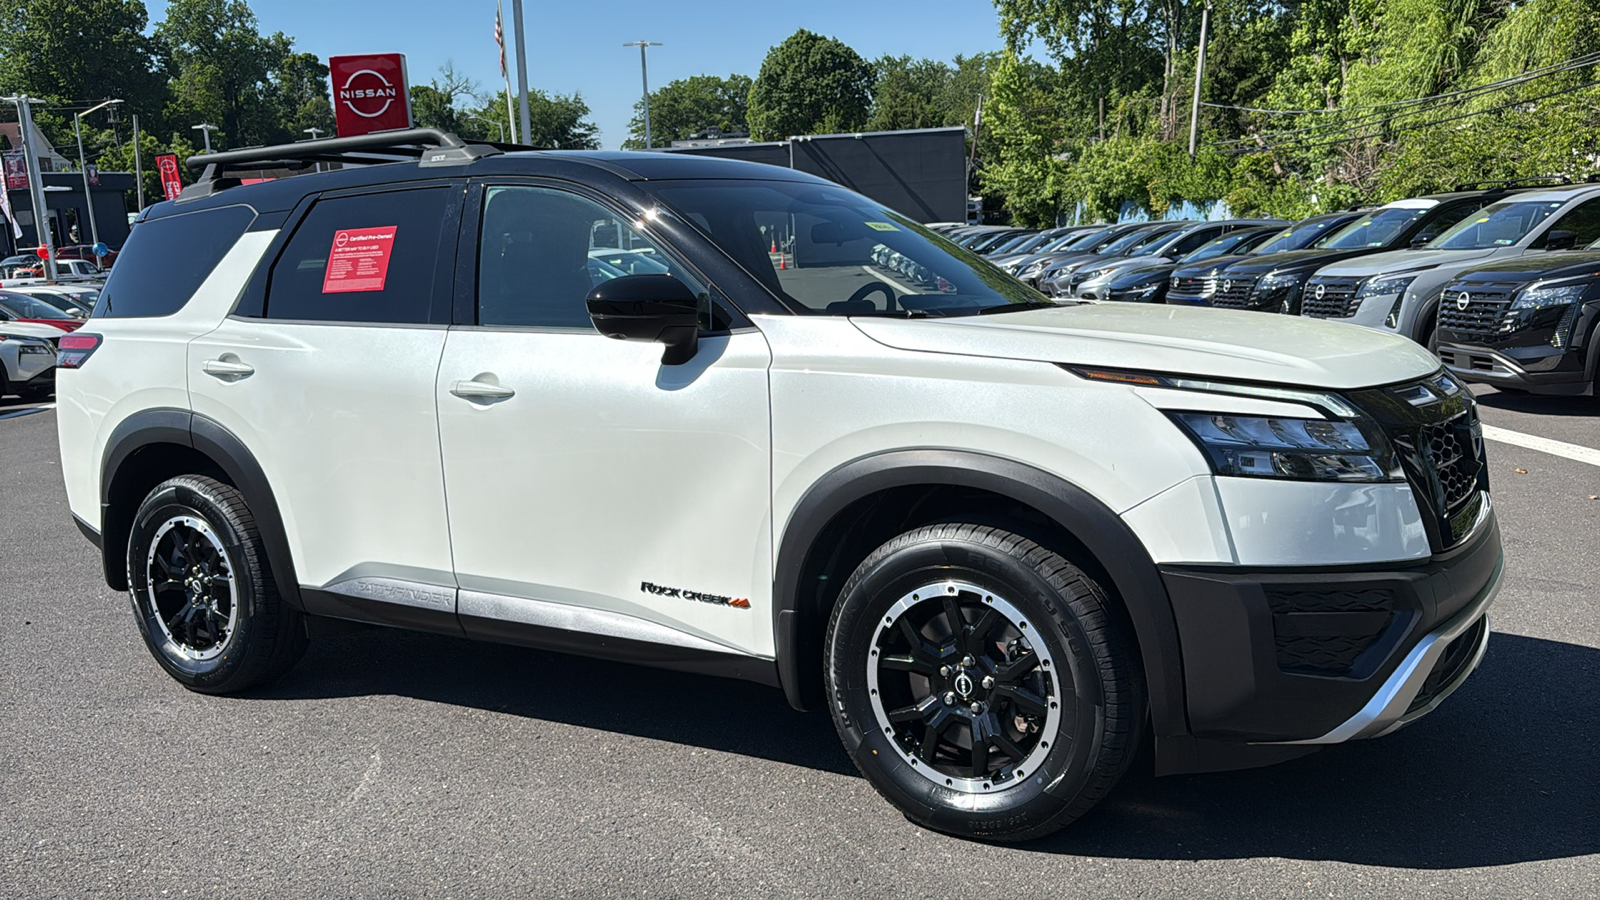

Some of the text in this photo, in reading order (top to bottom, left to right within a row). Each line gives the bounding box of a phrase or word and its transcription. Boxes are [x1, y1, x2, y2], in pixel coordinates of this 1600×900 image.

[340, 88, 396, 99] NISSAN
[357, 581, 451, 607] PATHFINDER
[641, 581, 732, 607] ROCK CREEK
